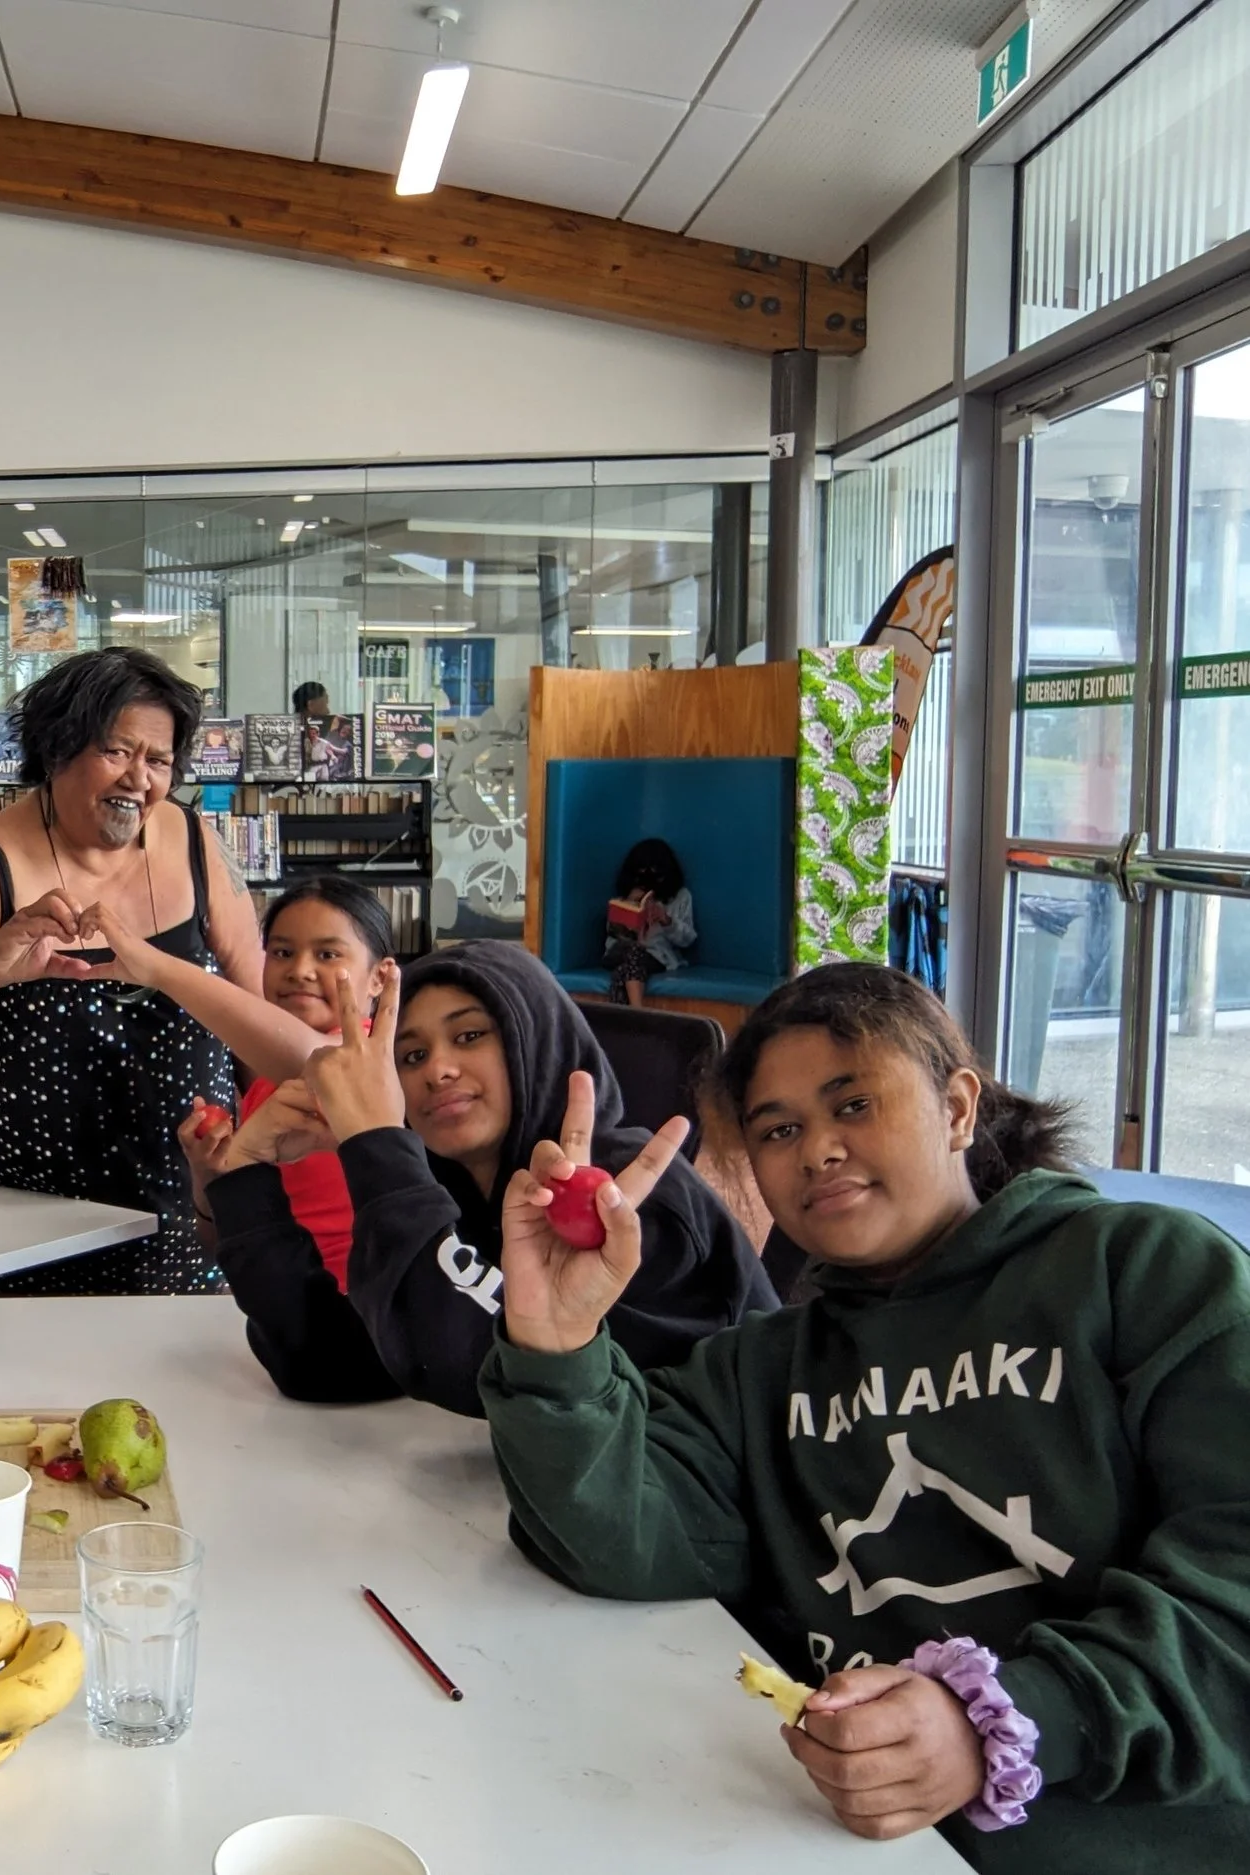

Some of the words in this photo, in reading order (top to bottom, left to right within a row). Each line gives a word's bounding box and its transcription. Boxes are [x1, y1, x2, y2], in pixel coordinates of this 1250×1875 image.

[365, 644, 407, 659] CAFE
[1184, 660, 1250, 690] EMERGEN
[1025, 678, 1081, 703] EMERGENCY
[1083, 675, 1106, 699] EXIT
[1107, 672, 1136, 698] ONLY
[375, 710, 423, 725] GMAT
[375, 724, 405, 732] Official
[352, 716, 362, 745] JULIUS
[194, 768, 238, 776] YELLING?
[353, 746, 363, 778] CAESAR
